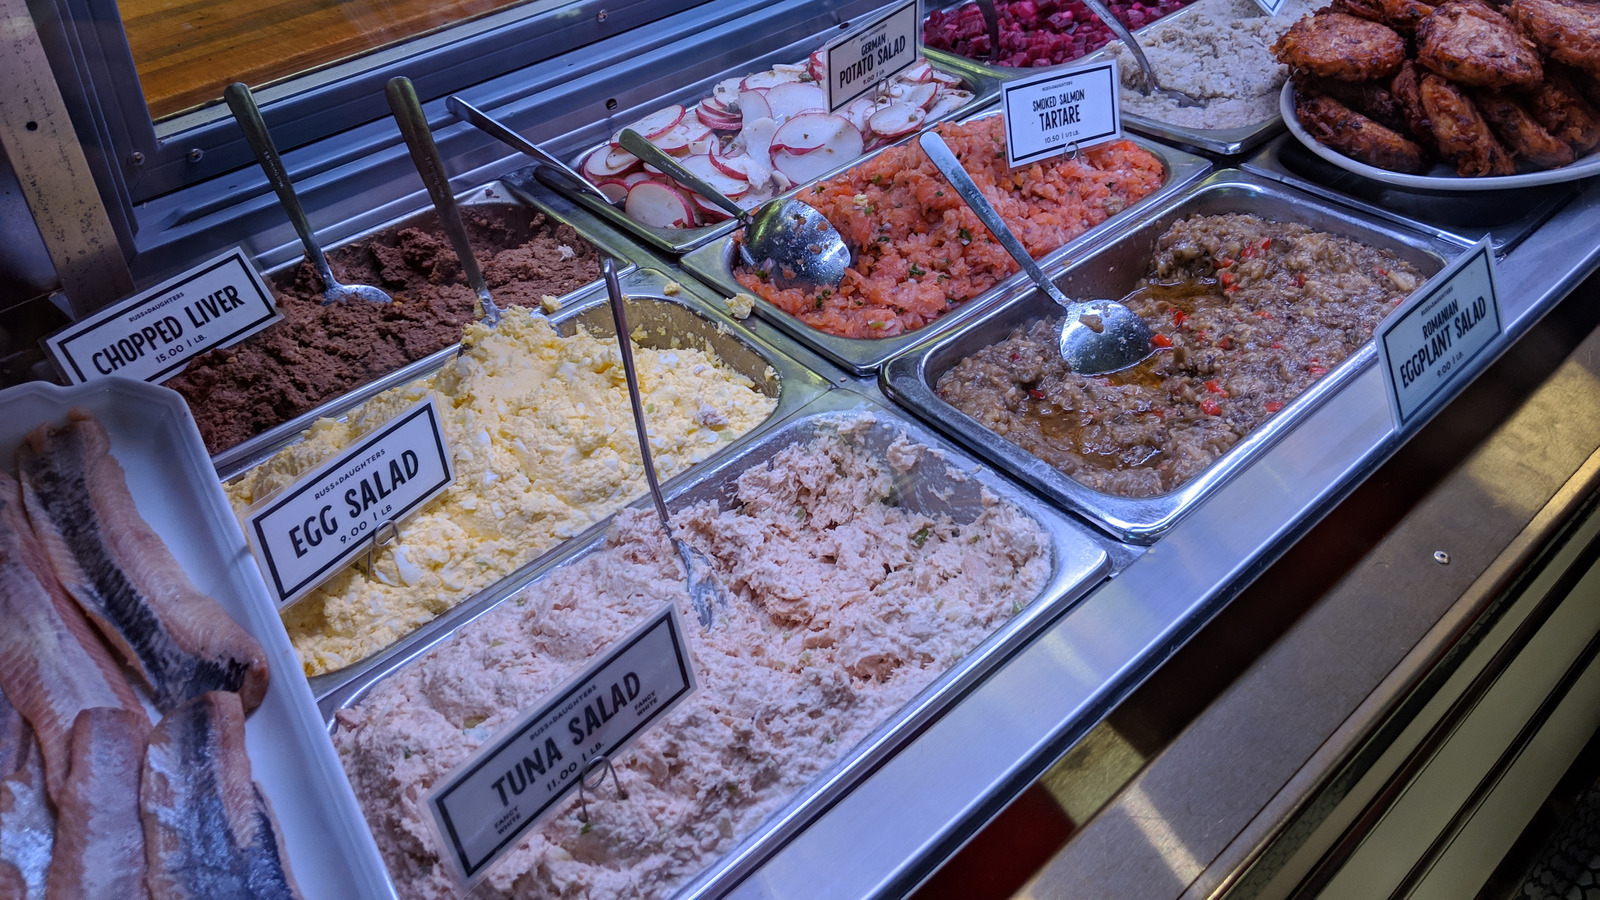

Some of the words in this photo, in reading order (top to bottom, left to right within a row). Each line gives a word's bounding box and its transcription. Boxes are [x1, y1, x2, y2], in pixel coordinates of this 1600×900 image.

[861, 33, 886, 56] GERMAN
[840, 53, 873, 89] POTATO
[877, 35, 905, 65] SALAD
[1032, 95, 1057, 112] SMOKED
[1059, 88, 1085, 105] SALMON
[1039, 104, 1081, 131] TARTARE
[1044, 135, 1059, 144] 10.50
[128, 292, 185, 323] RUSS&DAUGHTERS
[1422, 299, 1458, 340] ROMANIAN
[92, 316, 183, 375] CHOPPED
[184, 285, 245, 328] LIVER
[1400, 324, 1452, 389] EGGPLANT
[1454, 296, 1486, 339] SALAD
[155, 345, 184, 364] 15.00
[194, 334, 207, 344] LB.
[314, 449, 386, 500] RUSS&DAUGHTERS
[288, 505, 339, 559] EGG
[344, 449, 419, 518] SALAD
[340, 521, 367, 544] 9.00
[381, 505, 392, 516] LB
[634, 690, 656, 711] FANCY
[636, 698, 657, 717] WHITE
[491, 736, 563, 807] TUNA
[568, 672, 640, 746] SALAD
[546, 762, 577, 792] 11.00
[590, 741, 604, 755] LB.
[494, 805, 518, 829] FANCY
[497, 813, 522, 835] WHITE
